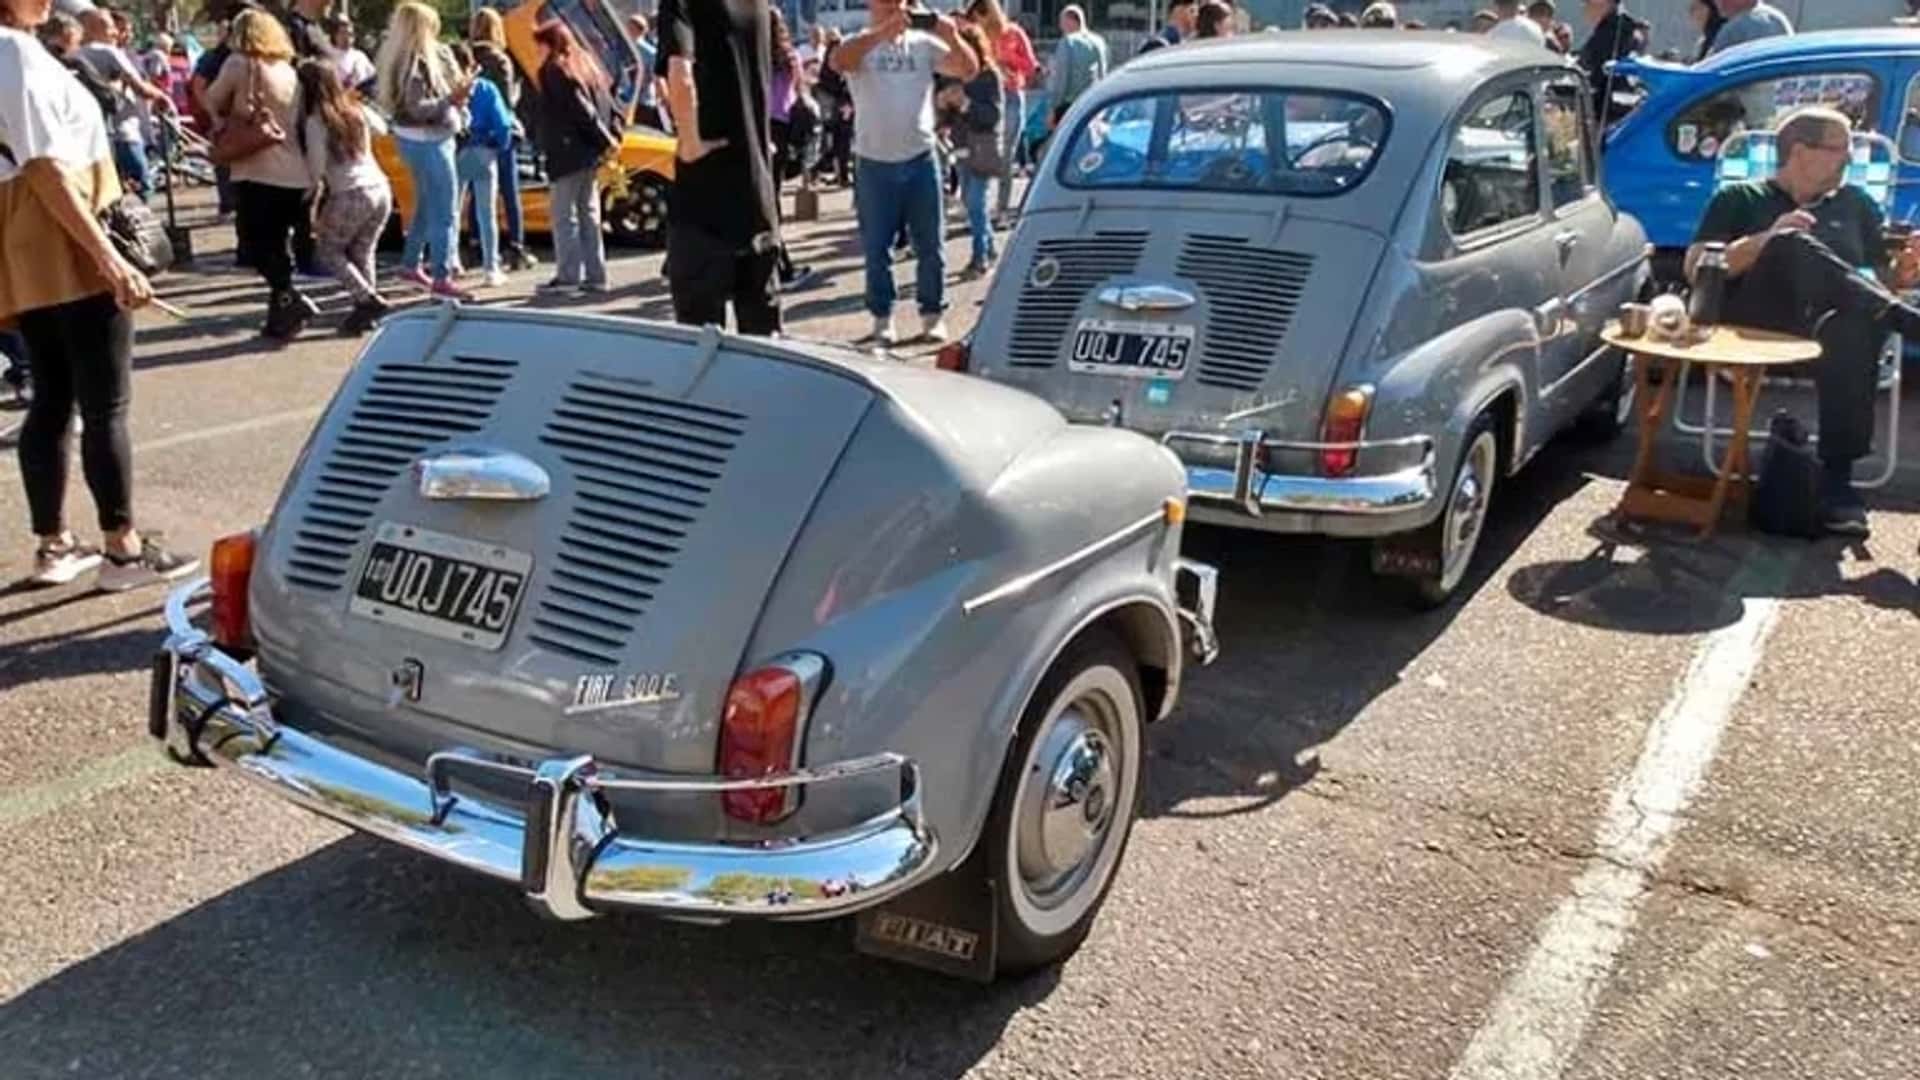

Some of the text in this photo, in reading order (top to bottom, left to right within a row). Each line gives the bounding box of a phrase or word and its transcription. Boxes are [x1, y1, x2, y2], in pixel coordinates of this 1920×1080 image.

[1075, 332, 1188, 368] UQJ 745
[574, 674, 614, 705] FIAT
